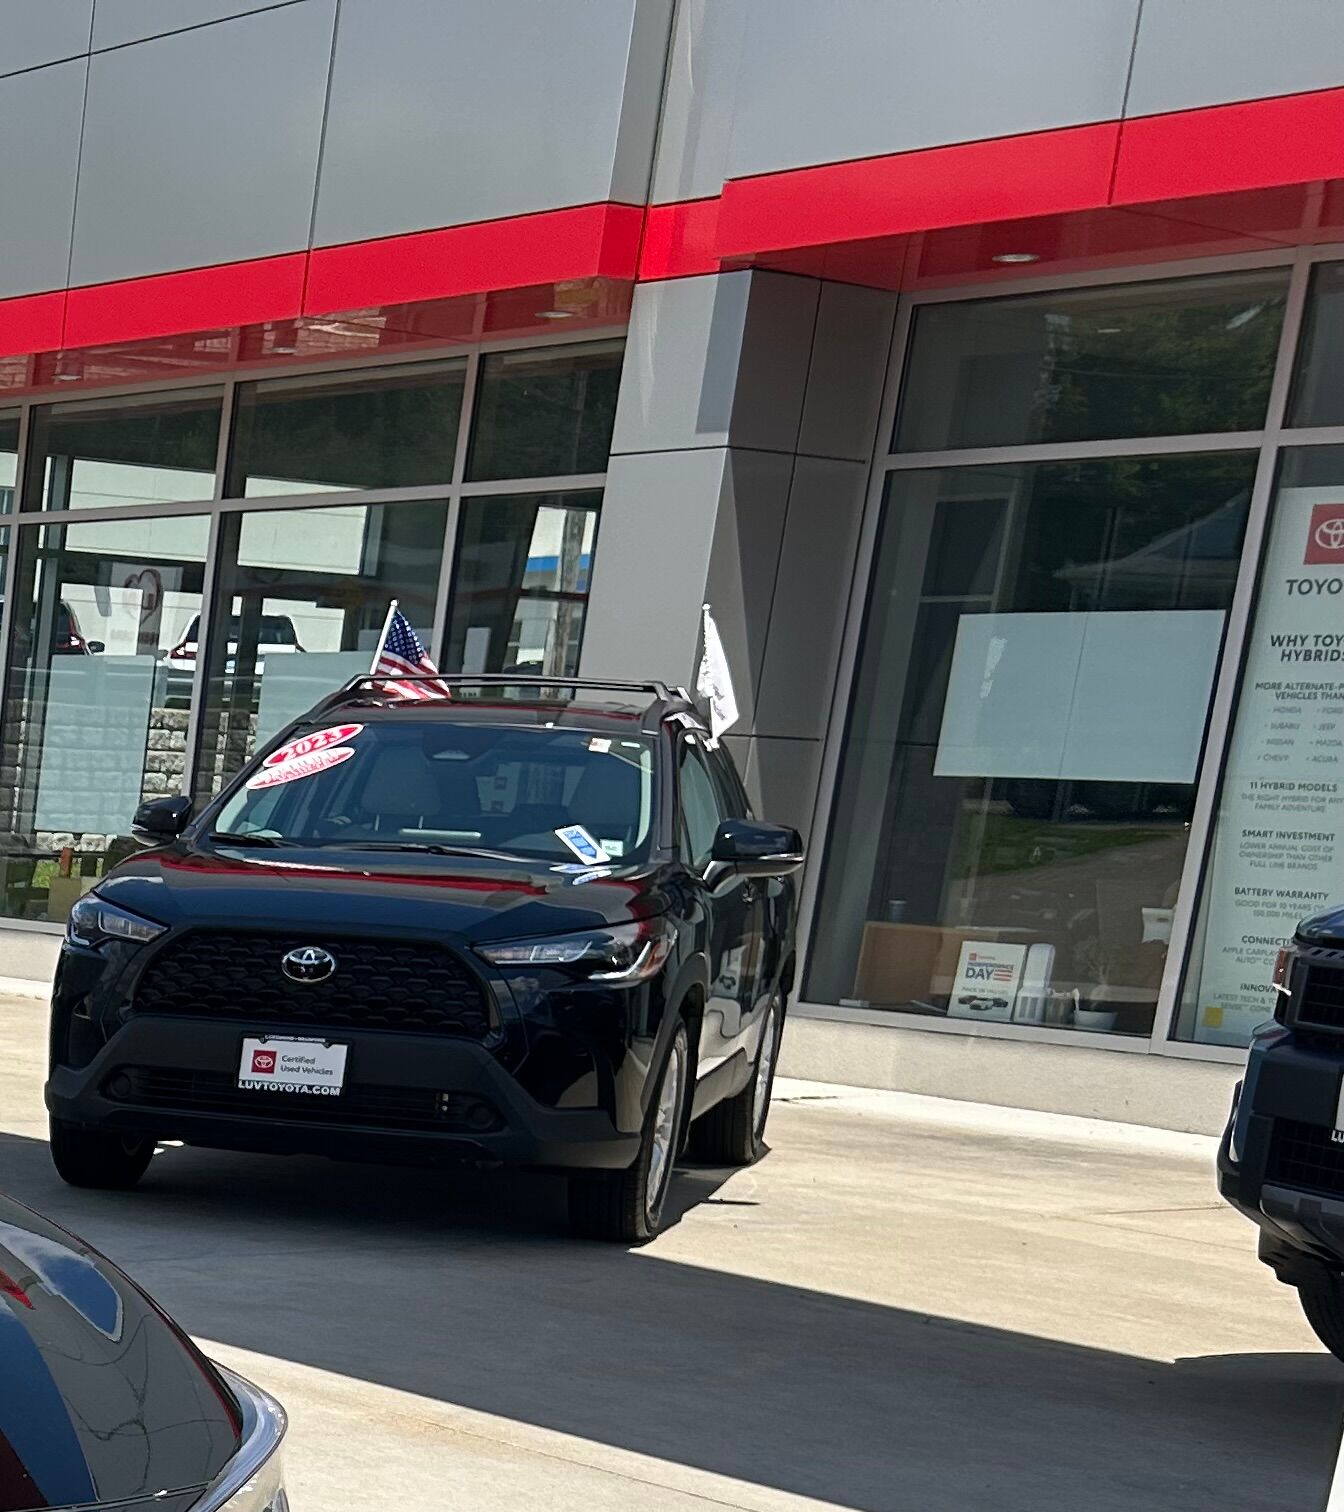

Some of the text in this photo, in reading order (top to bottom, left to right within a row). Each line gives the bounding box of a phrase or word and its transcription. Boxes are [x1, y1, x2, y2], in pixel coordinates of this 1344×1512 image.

[1270, 634, 1344, 648] WHY TOY
[1280, 649, 1344, 662] HYBRID
[1254, 682, 1283, 691] MORE
[1275, 691, 1318, 701] VEHICLES
[283, 729, 343, 758] 2023
[1250, 782, 1338, 793] 11 HYBRID MODELS
[1241, 829, 1336, 842] SMART INVESTMENT
[1234, 886, 1329, 901] BATTERY WARRANTY
[965, 966, 994, 981] DAY
[281, 1055, 316, 1065] Certified
[280, 1064, 334, 1076] Used Vehicles
[238, 1080, 341, 1097] LUVTOYOTA.COM
